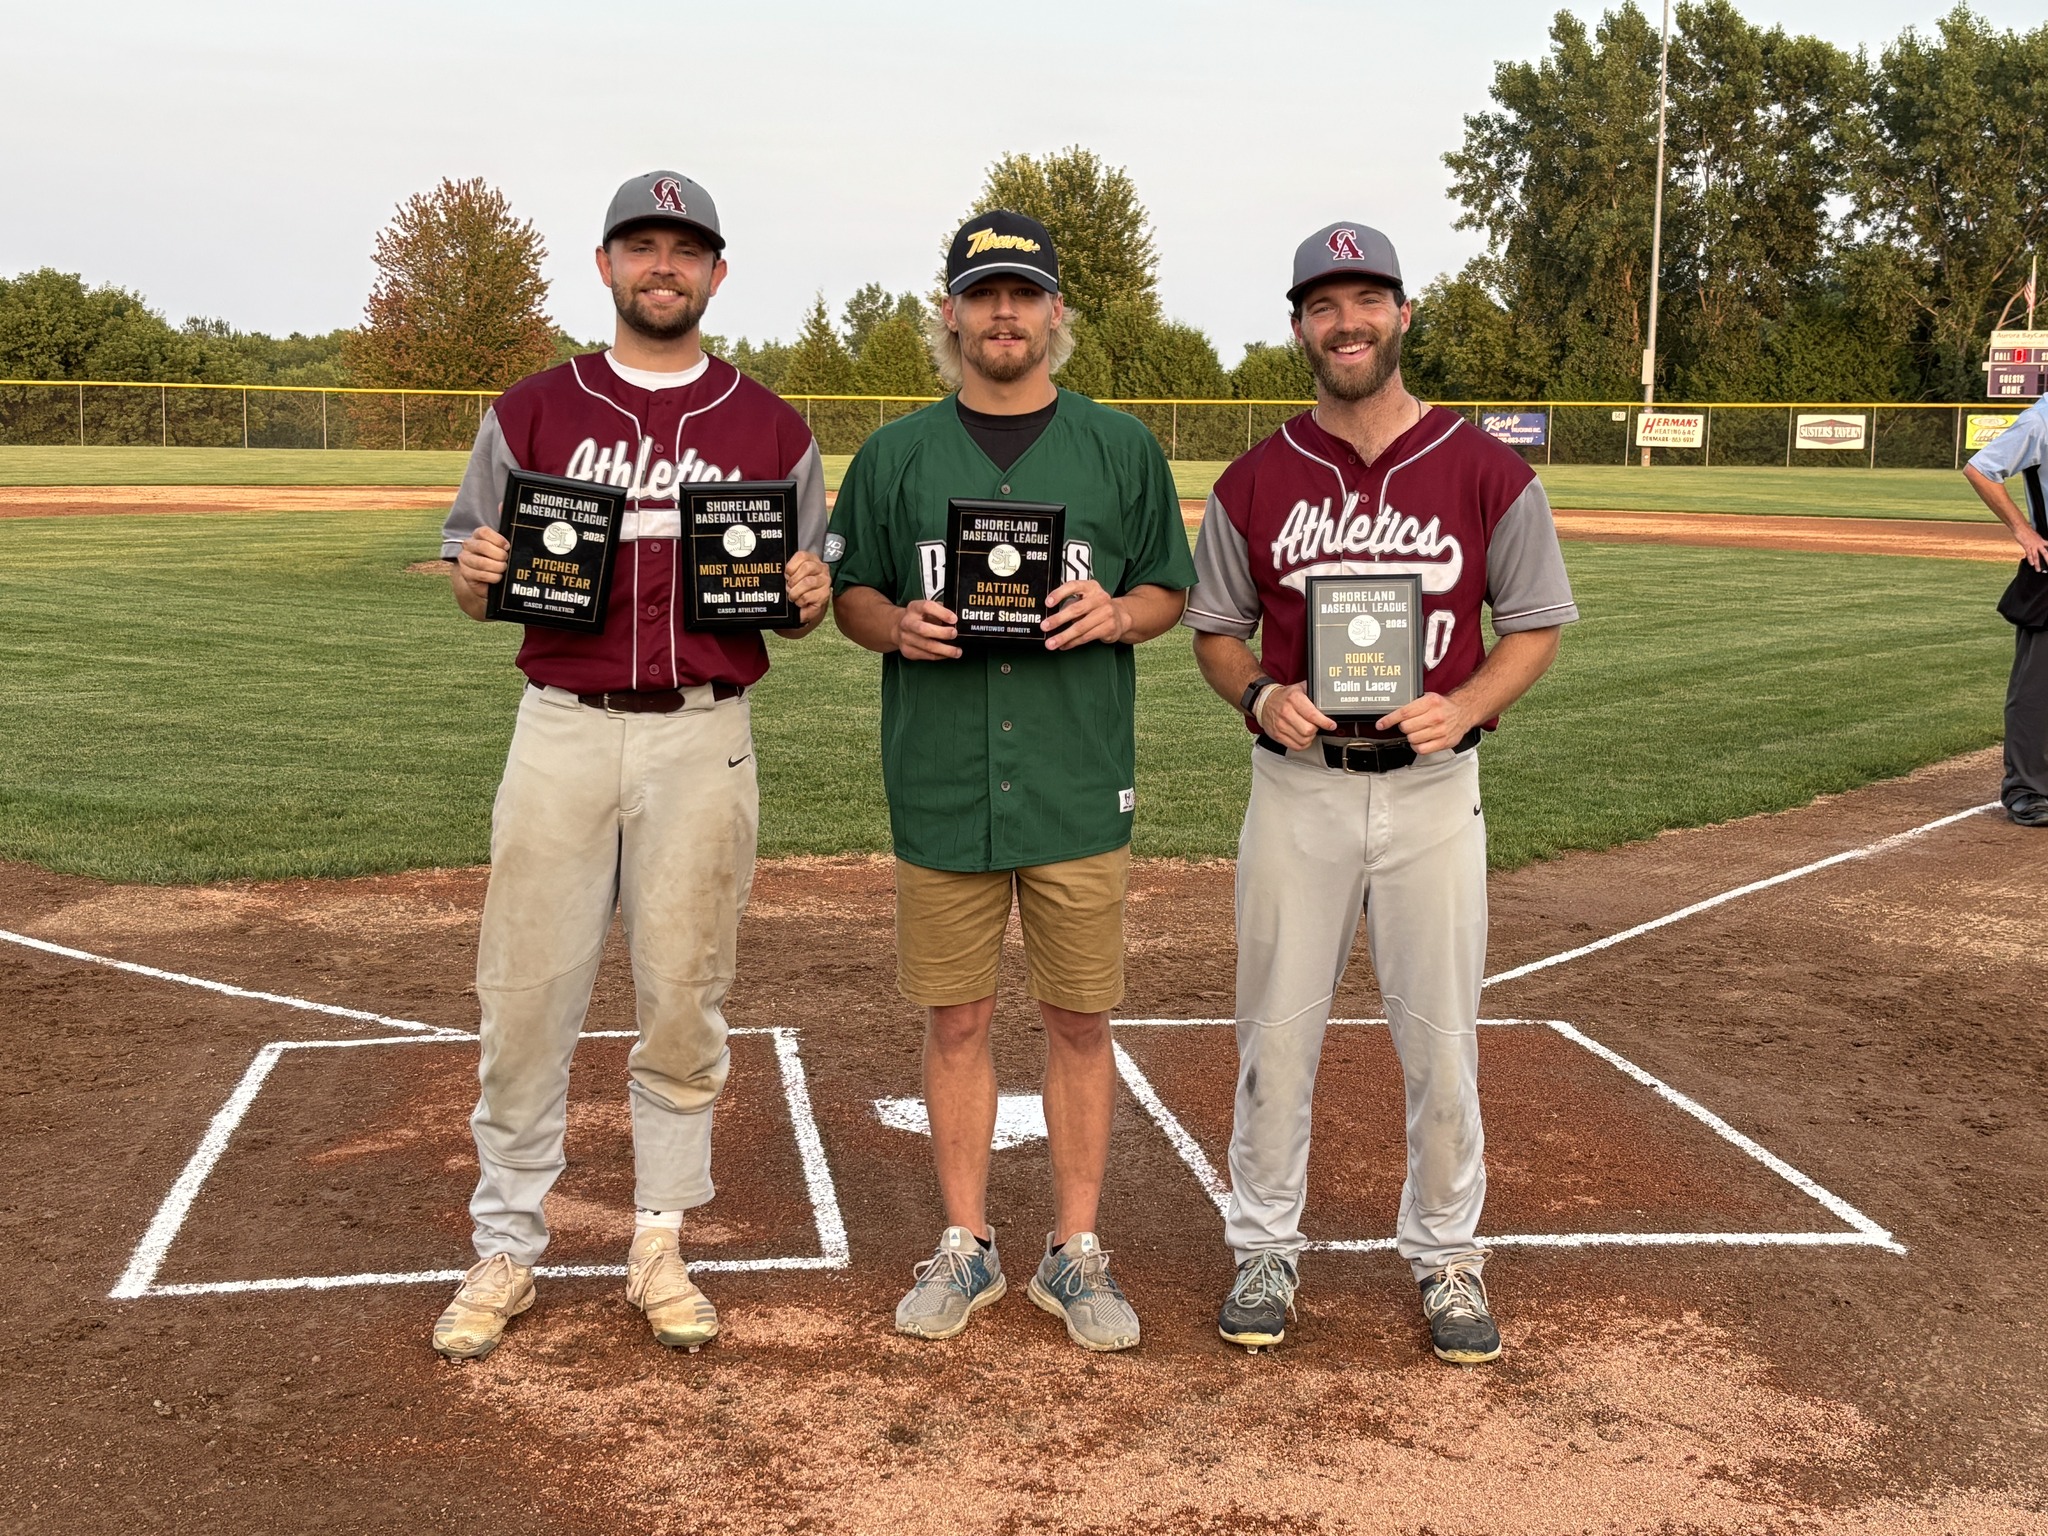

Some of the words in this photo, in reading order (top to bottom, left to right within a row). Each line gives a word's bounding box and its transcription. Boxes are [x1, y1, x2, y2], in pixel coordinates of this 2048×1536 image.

[1999, 374, 2025, 384] GUESTS
[2001, 385, 2021, 395] HOME
[1833, 426, 1862, 438] TAVERN
[532, 492, 599, 514] SHORELAND
[706, 500, 770, 512] SHORELAND
[519, 503, 567, 520] BASEBALL
[572, 512, 609, 527] LEAGUE
[695, 513, 743, 524] BASEBALL
[747, 512, 782, 523] LEAGUE
[974, 519, 1039, 533] SHORELAND
[1271, 490, 1446, 570] Athletics
[582, 531, 605, 543] 2025
[760, 529, 783, 539] 2025
[962, 530, 1010, 543] BASEBALL
[1014, 532, 1049, 545] LEAGUE
[1026, 551, 1048, 561] 2025
[531, 558, 580, 575] PITCHER
[699, 564, 728, 576] MOST
[732, 563, 782, 574] VALUABLE
[516, 569, 531, 581] OF
[535, 571, 556, 585] THE
[562, 575, 591, 590] YEAR
[722, 576, 760, 588] PLAYER
[977, 581, 1029, 595] BATTING
[511, 583, 540, 598] Noah
[544, 588, 591, 607] Lindsley
[703, 592, 731, 604] Noah
[735, 591, 780, 604] Lindsley
[968, 594, 1036, 608] CHAMPION
[1332, 591, 1396, 602] SHORELAND
[523, 601, 543, 609] CASCO
[544, 604, 575, 614] ATHLETICS
[1321, 602, 1368, 614] BASEBALL
[1372, 602, 1408, 613] LEAGUE
[961, 608, 995, 621] Carter
[998, 610, 1041, 624] Stebane
[1385, 619, 1408, 628] 2025
[1345, 653, 1385, 664] ROOKIE
[1328, 666, 1343, 678] OF
[1347, 665, 1368, 677] THE
[1372, 664, 1402, 676] YEAR
[1333, 680, 1361, 692] Colin
[1365, 680, 1398, 693] Lacey
